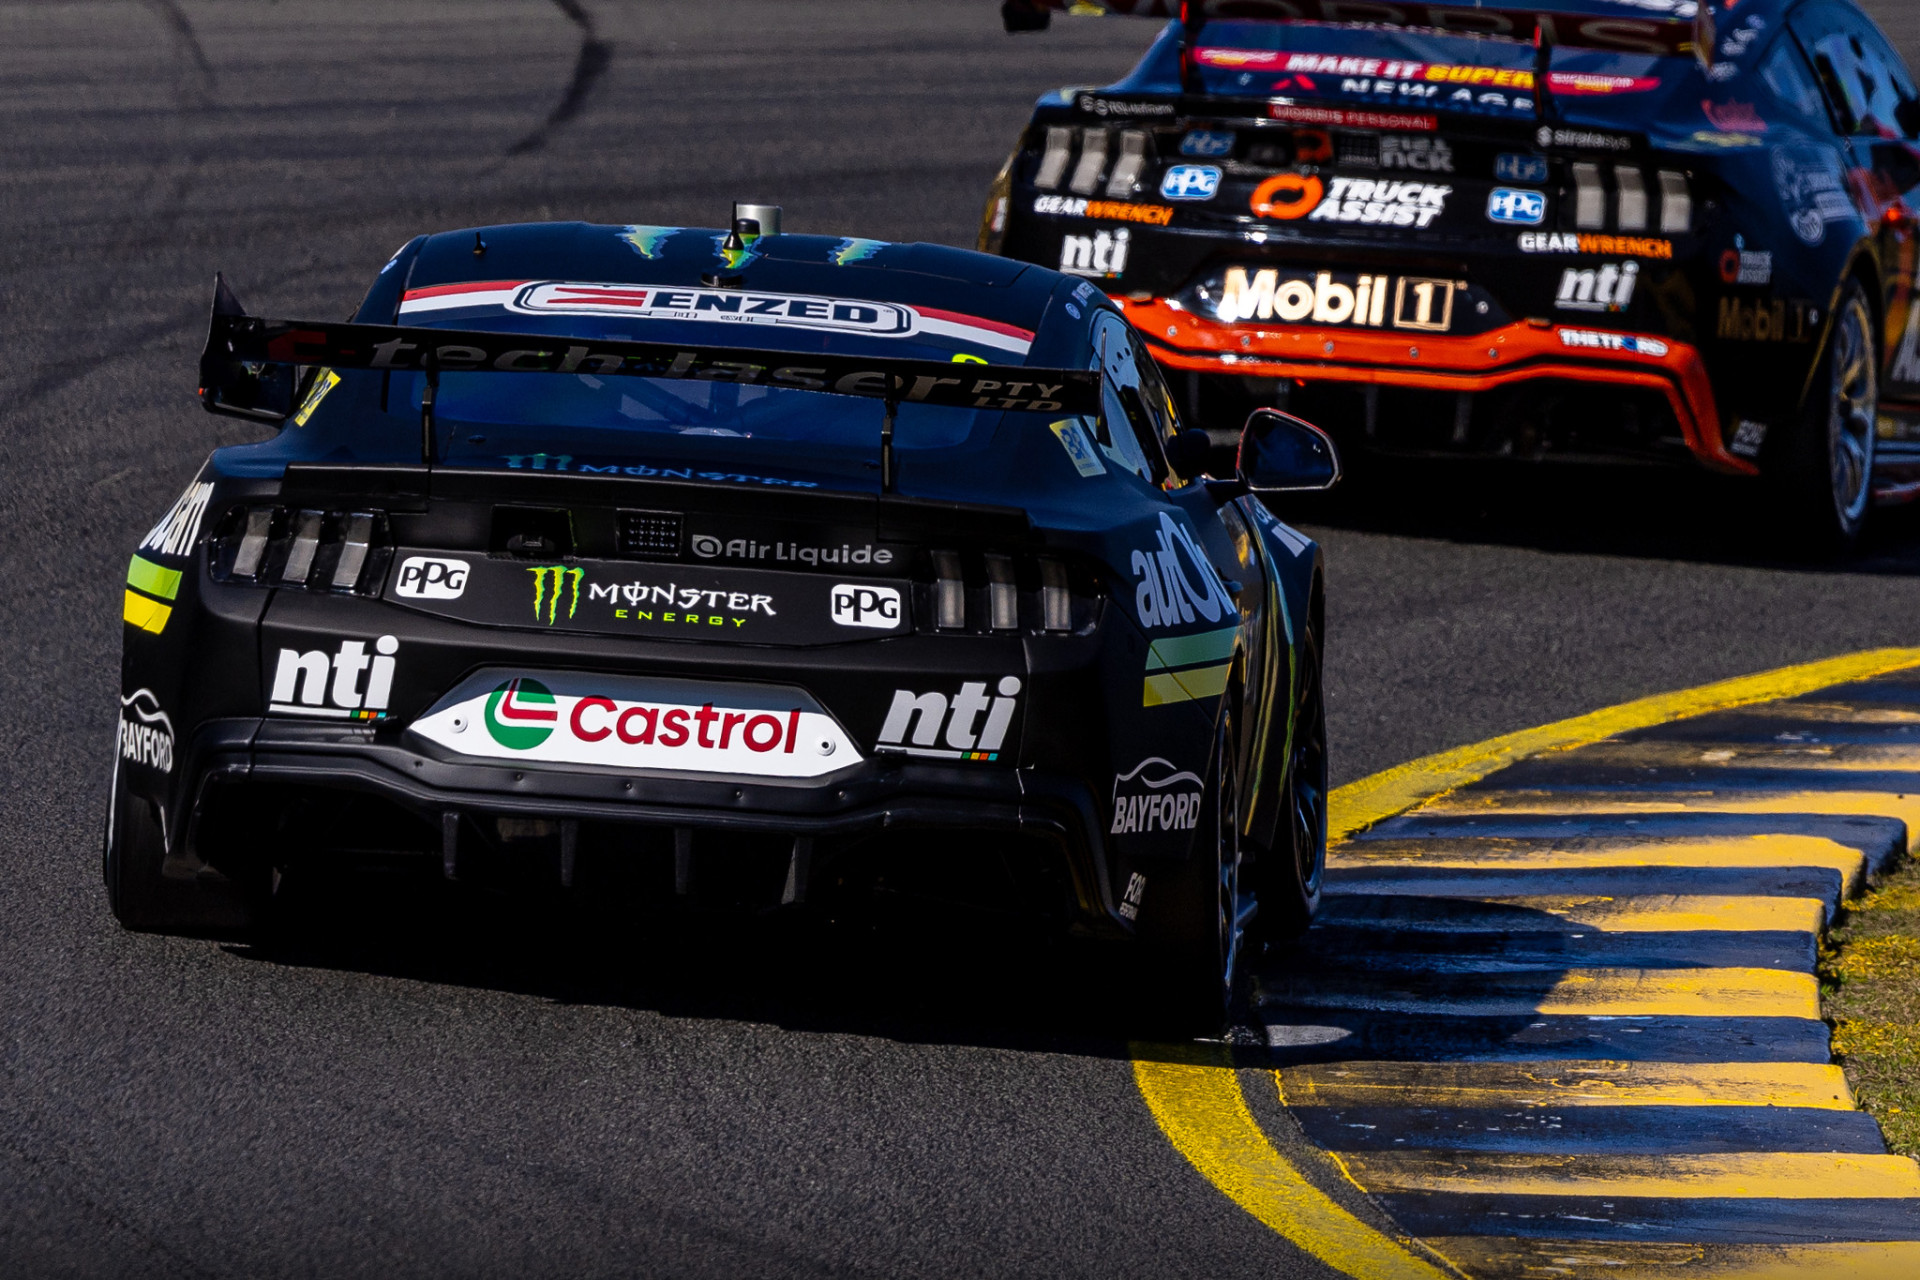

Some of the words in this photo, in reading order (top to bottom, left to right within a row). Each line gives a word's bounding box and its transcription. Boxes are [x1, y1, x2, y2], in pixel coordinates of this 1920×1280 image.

[1284, 53, 1380, 77] MAKE
[1381, 60, 1424, 79] IT
[1424, 64, 1533, 90] SUPER
[1329, 176, 1454, 207] TRUCK
[1308, 200, 1445, 229] ASSIST
[1061, 226, 1132, 272] nti
[1221, 266, 1389, 326] Mobil
[1556, 260, 1640, 304] nti
[649, 289, 879, 324] ENZED
[1716, 295, 1785, 342] Mobil
[657, 352, 964, 402] laser
[970, 380, 1065, 398] PTY
[971, 395, 1065, 412] LTD
[725, 537, 772, 560] Air
[777, 541, 893, 566] Liquide
[401, 562, 466, 594] PPG
[615, 609, 747, 628] ENERGY
[834, 590, 897, 622] PPG
[272, 635, 399, 709] nti
[570, 695, 801, 754] Castrol
[877, 676, 1023, 752] nti
[121, 719, 174, 774] BAYFORD
[1110, 792, 1202, 834] BAYFORD
